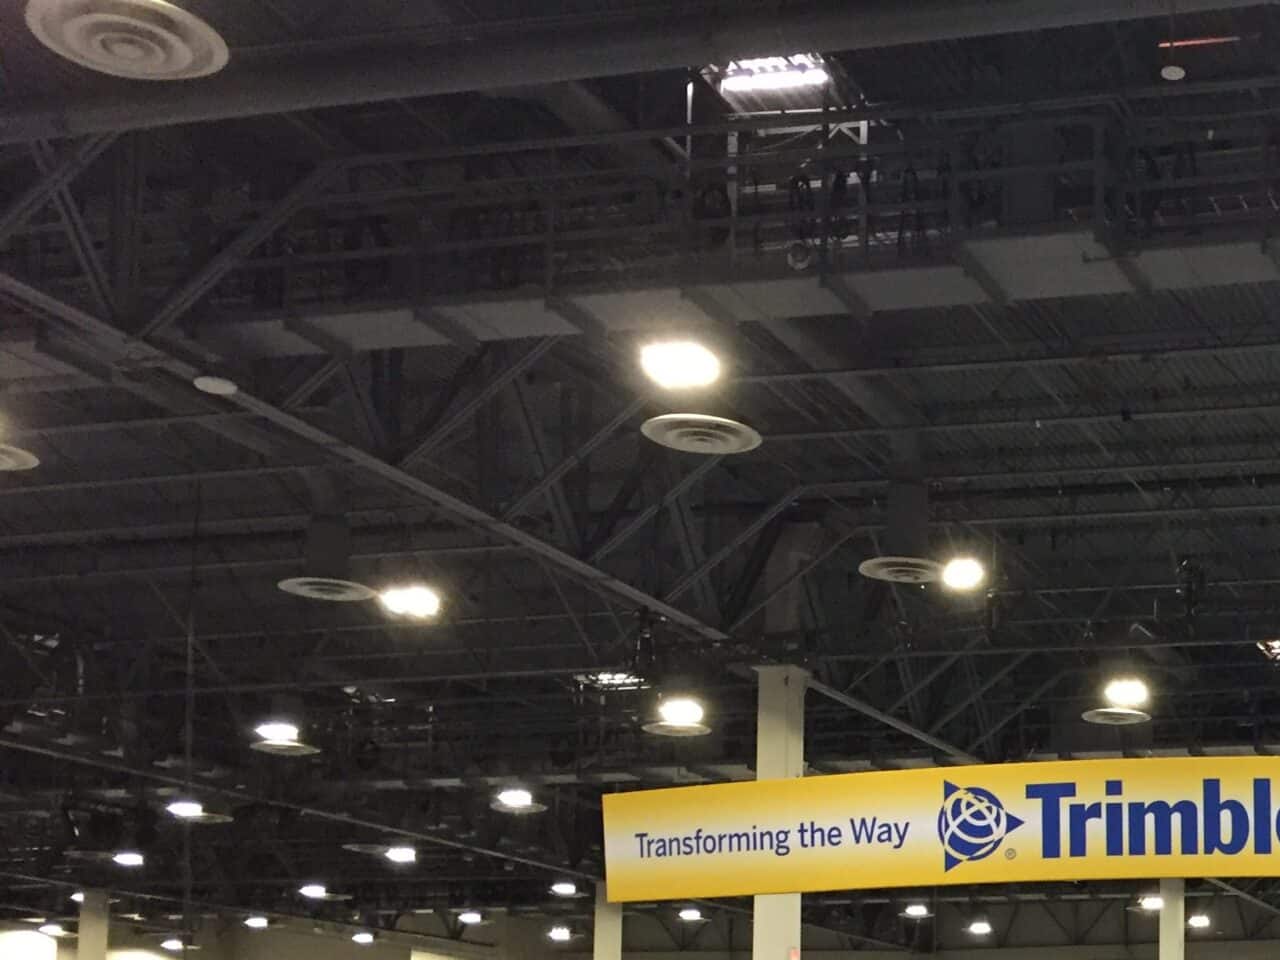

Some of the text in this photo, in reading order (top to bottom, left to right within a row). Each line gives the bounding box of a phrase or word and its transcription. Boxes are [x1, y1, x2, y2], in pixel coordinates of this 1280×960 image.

[635, 816, 910, 856] Transforming the Way
